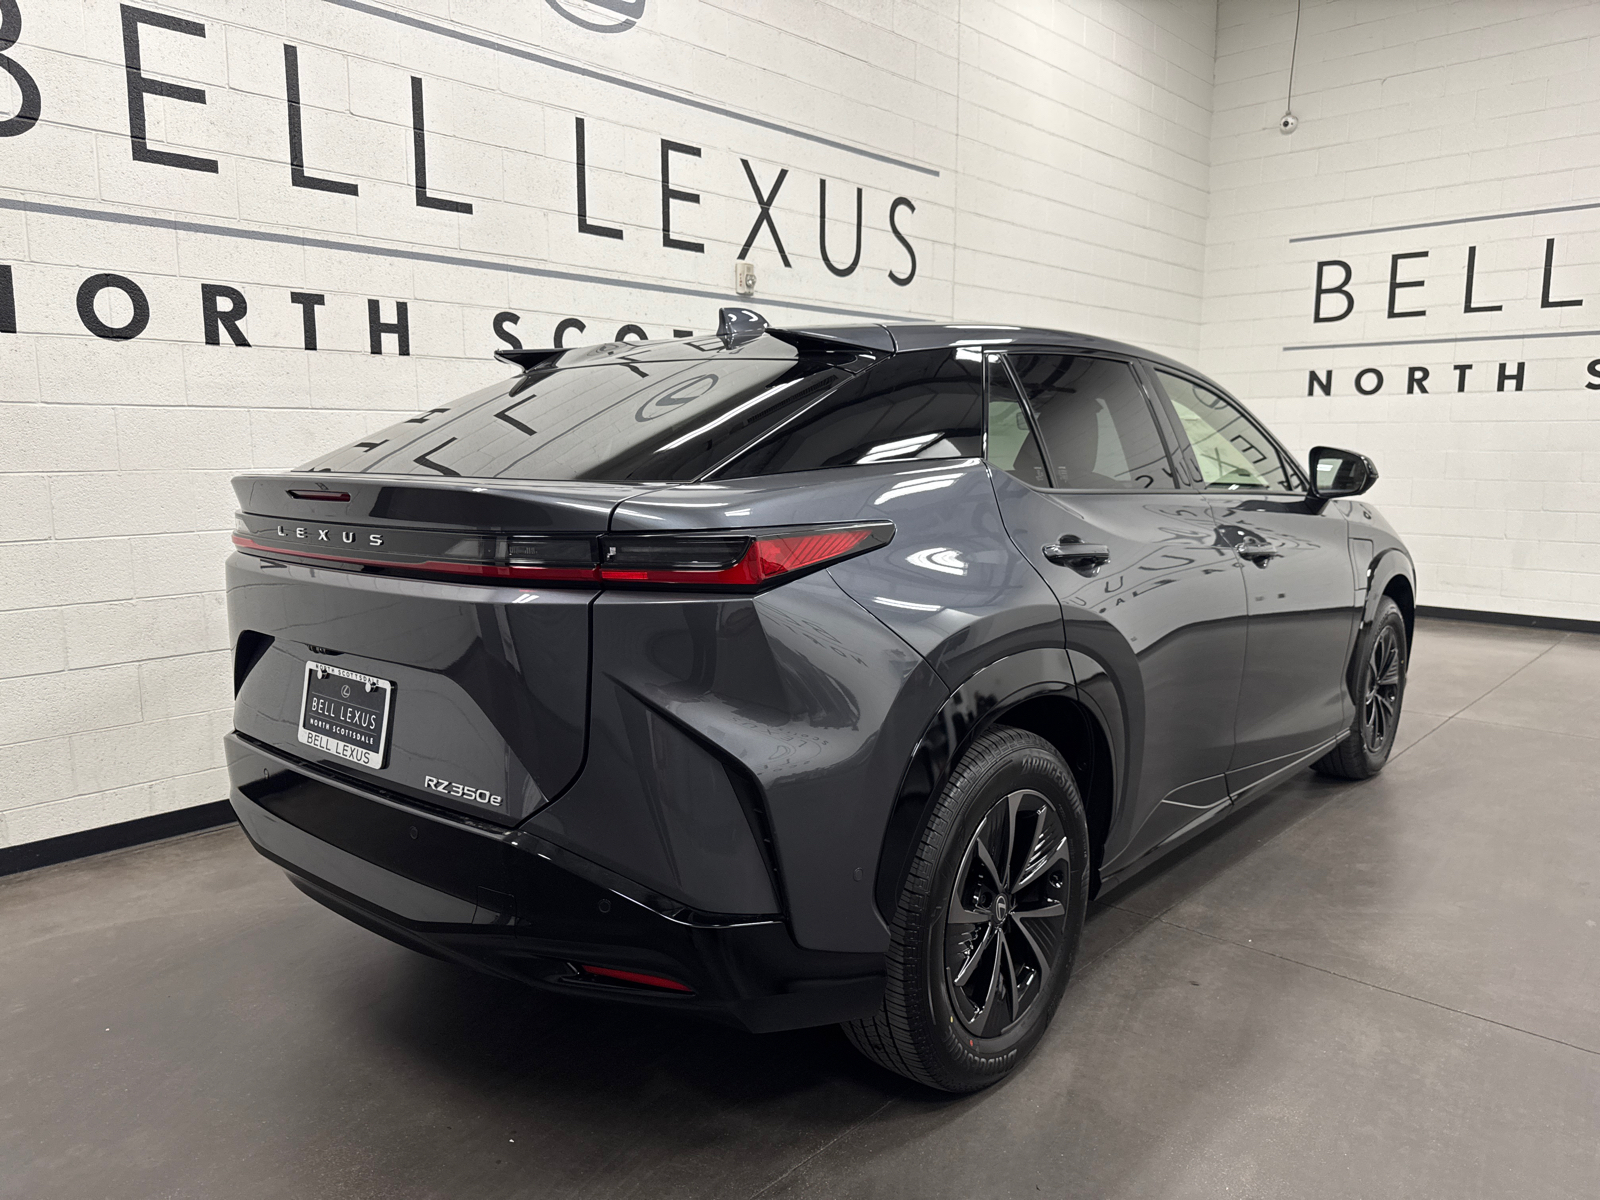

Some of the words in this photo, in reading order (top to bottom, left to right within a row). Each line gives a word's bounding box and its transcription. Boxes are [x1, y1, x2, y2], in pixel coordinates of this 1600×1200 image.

[575, 117, 916, 286] LEXUS
[1313, 238, 1583, 323] BELL
[0, 264, 411, 357] ORTH
[1307, 361, 1526, 397] NORTH
[277, 525, 384, 546] LEXUS
[316, 663, 335, 673] NORTH
[311, 697, 335, 717] BELL
[340, 706, 376, 729] LEXUS
[307, 732, 331, 751] BELL
[335, 742, 370, 764] LEXUS
[310, 718, 330, 730] NORTH
[332, 725, 373, 745] SCOTTSDALE
[1021, 754, 1083, 818] BRIDGESTONE
